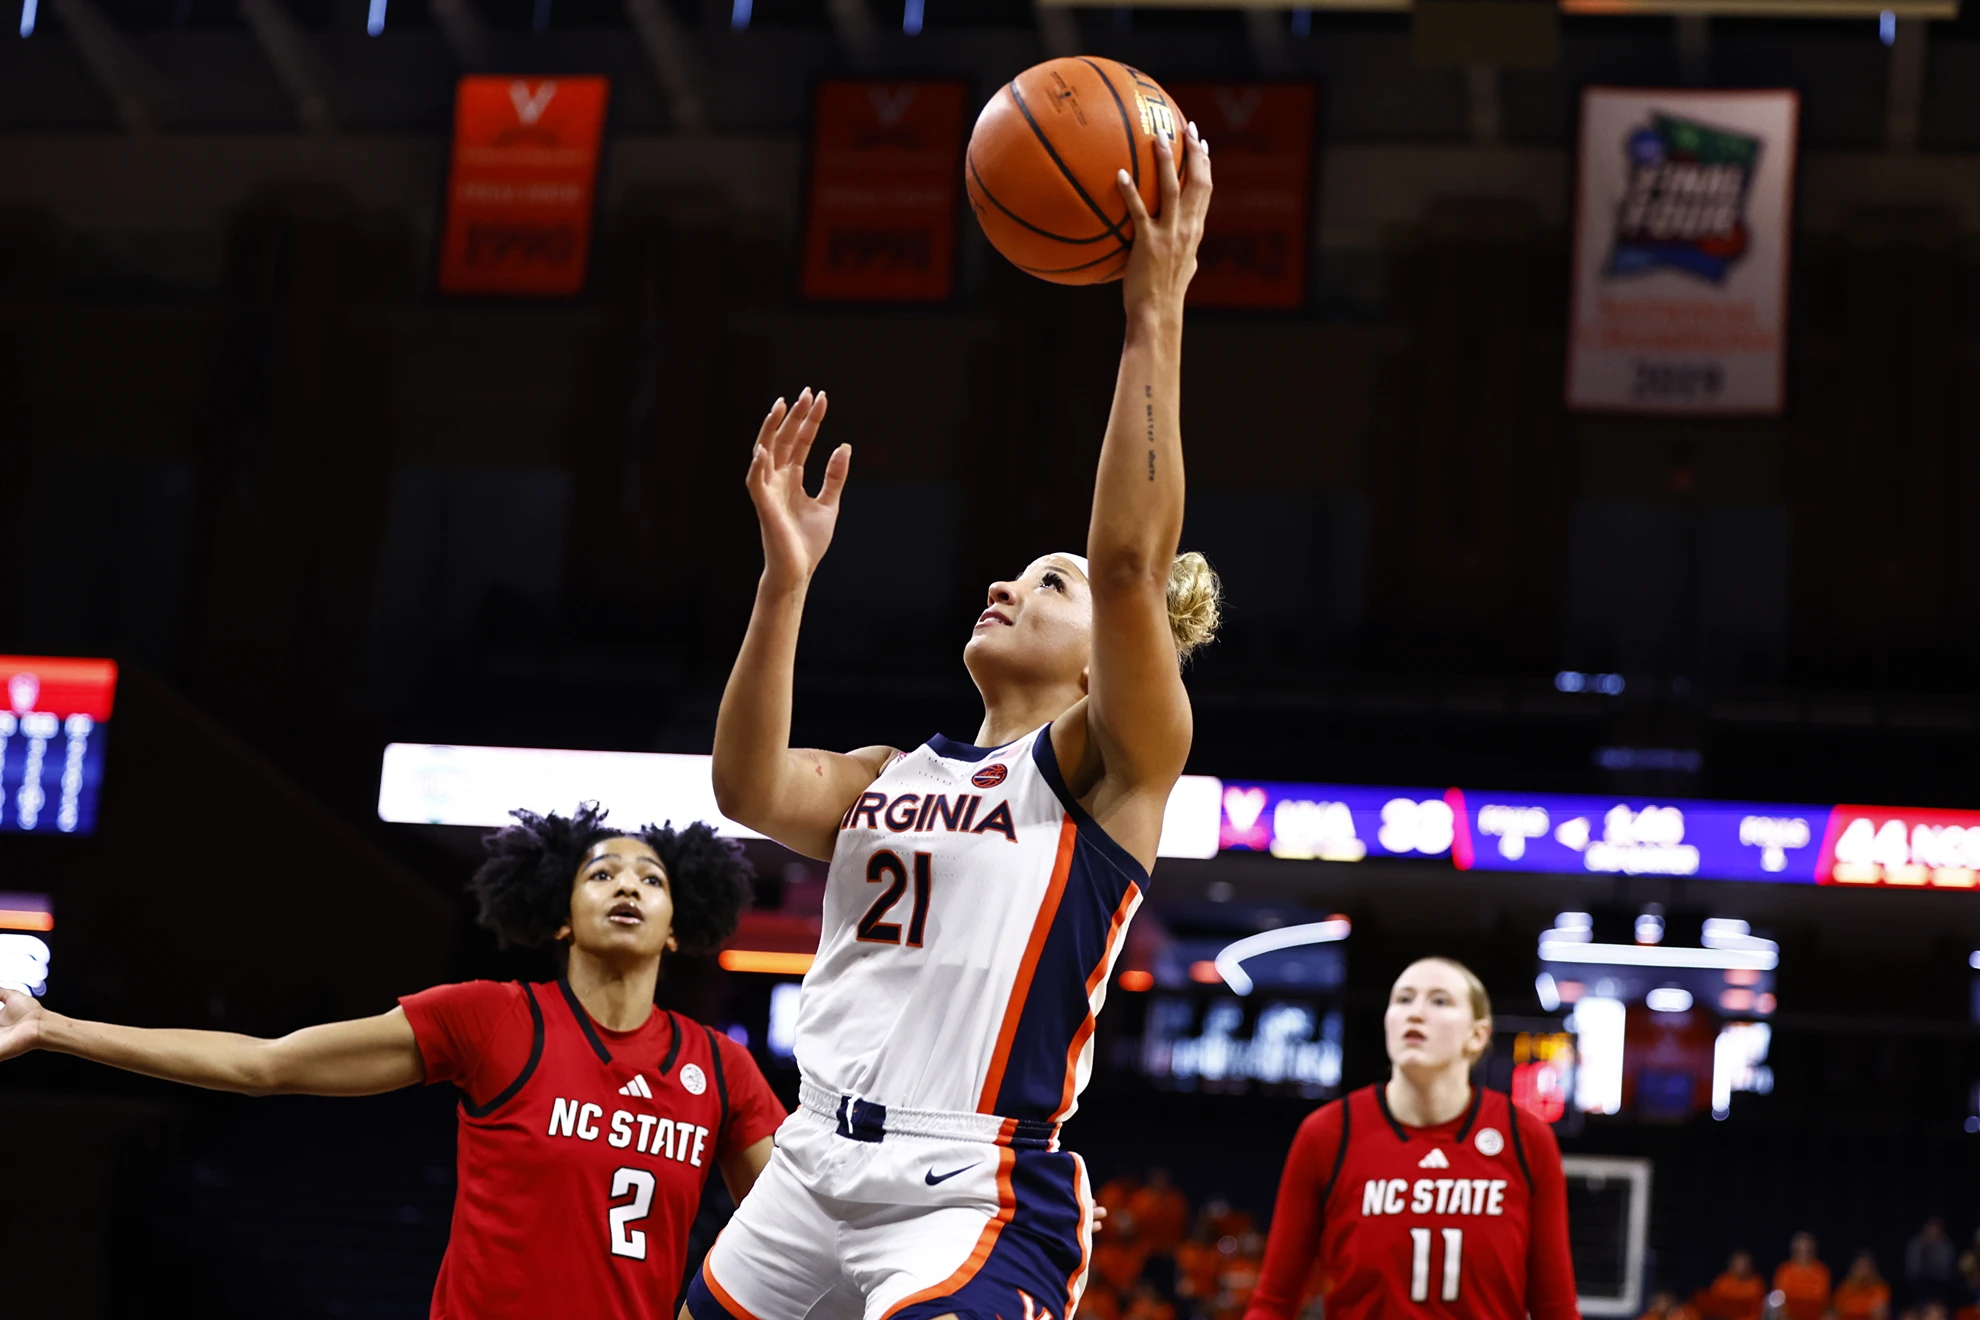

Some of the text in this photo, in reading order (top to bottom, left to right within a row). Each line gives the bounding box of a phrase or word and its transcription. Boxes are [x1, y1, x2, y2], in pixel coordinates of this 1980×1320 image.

[840, 792, 1018, 843] IRGINIA
[856, 849, 932, 948] 21
[548, 1097, 709, 1168] NC STATE
[609, 1165, 656, 1262] 2
[1362, 1178, 1507, 1217] NC STATE
[1409, 1227, 1463, 1302] 11
